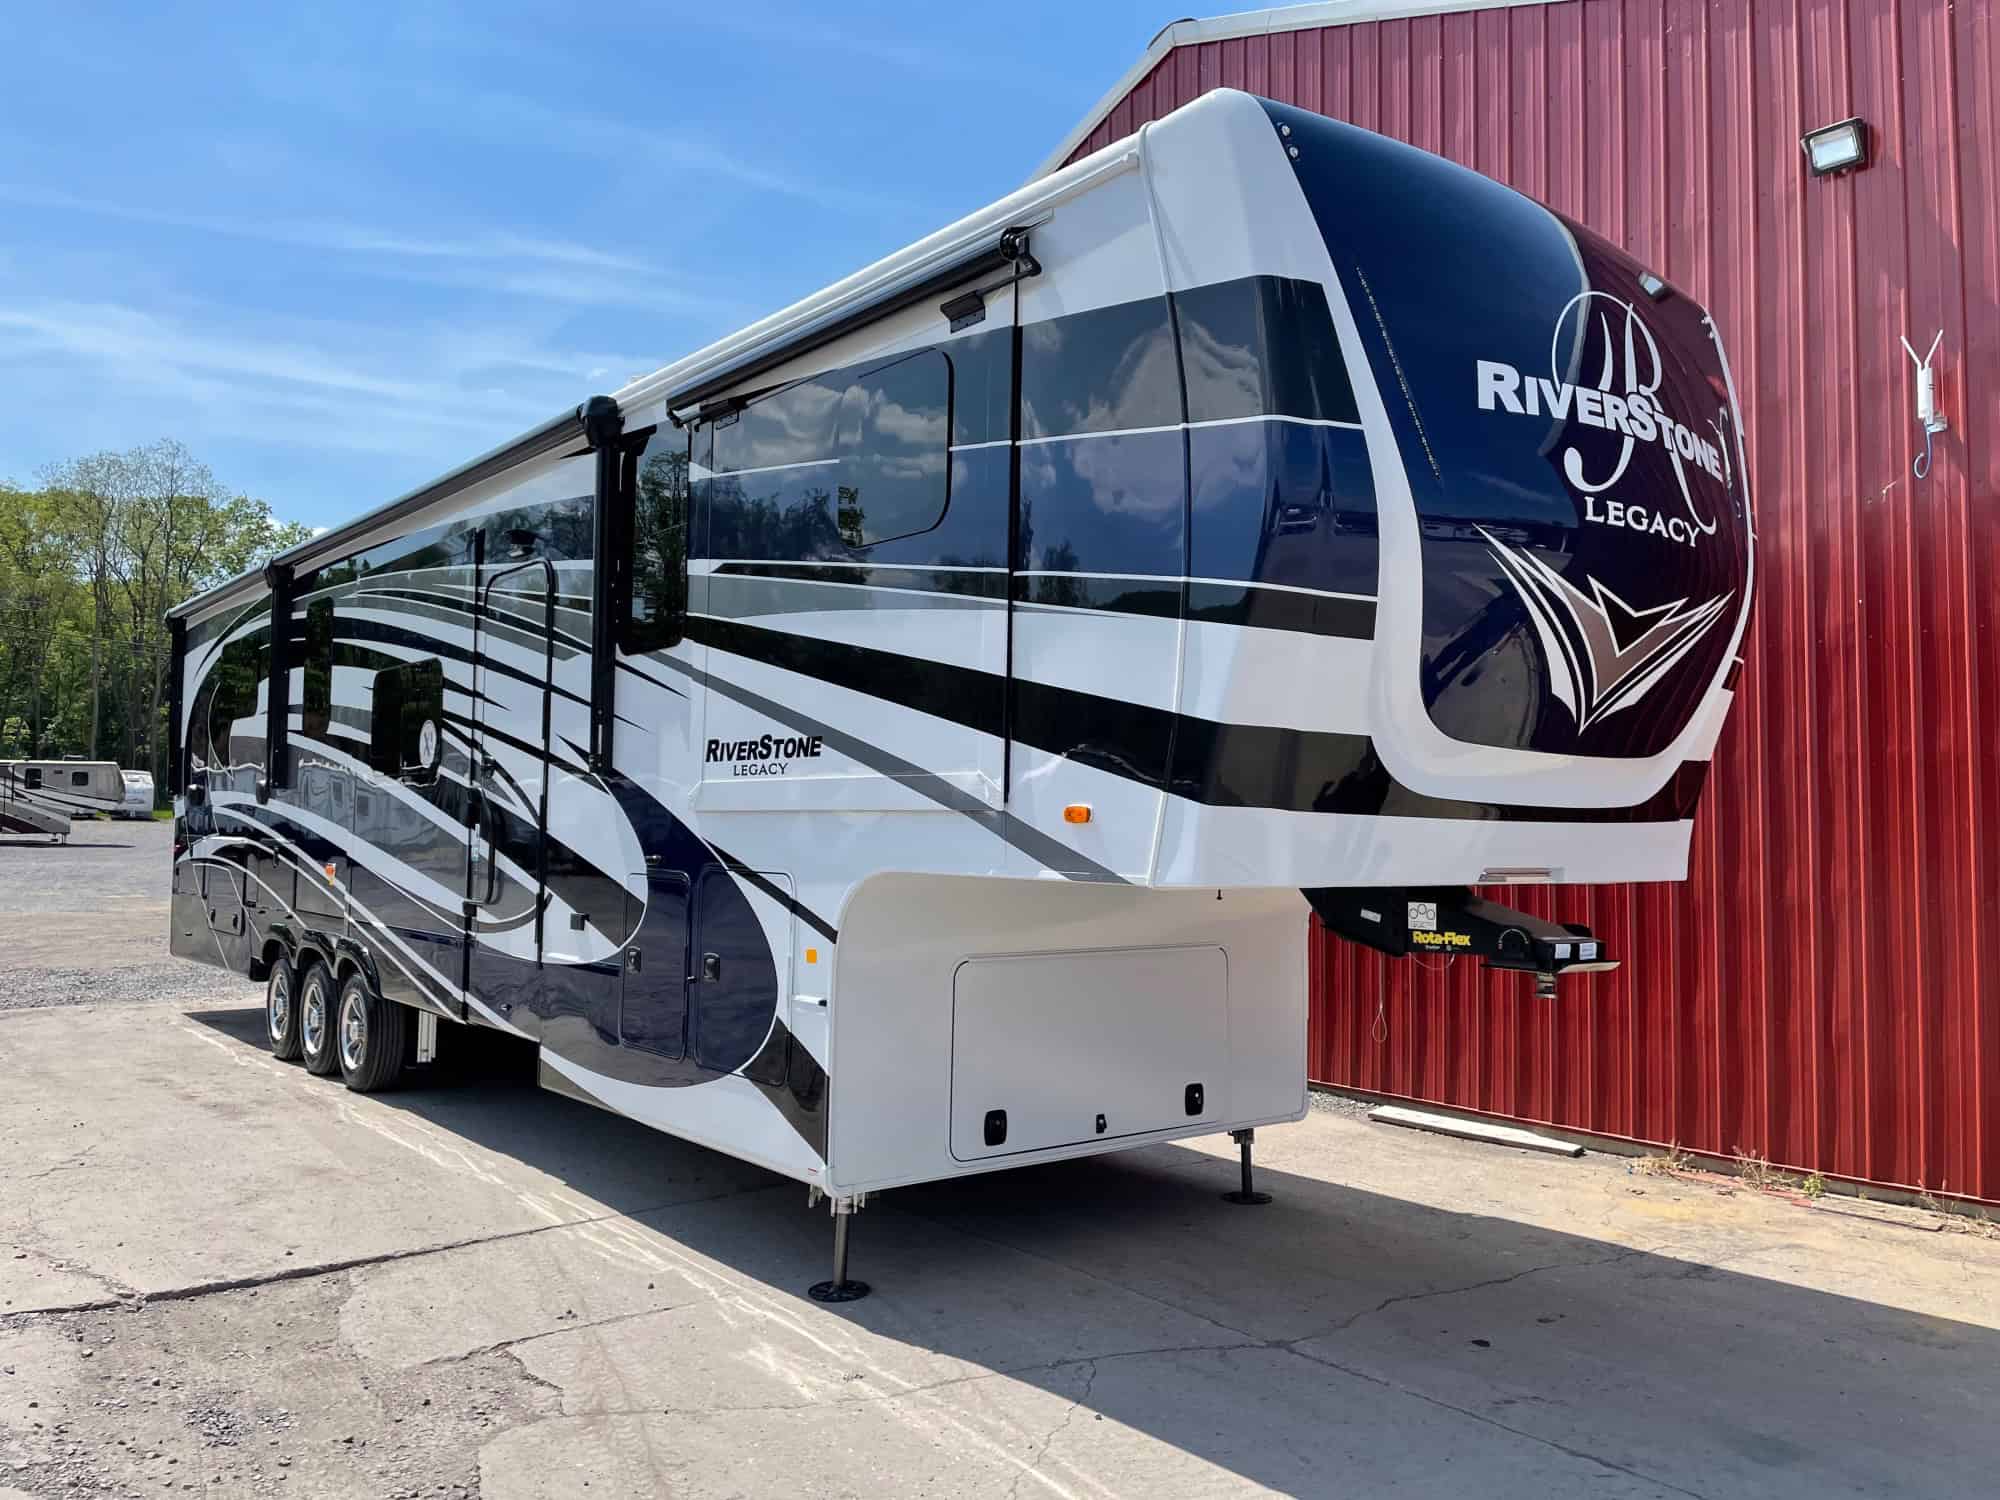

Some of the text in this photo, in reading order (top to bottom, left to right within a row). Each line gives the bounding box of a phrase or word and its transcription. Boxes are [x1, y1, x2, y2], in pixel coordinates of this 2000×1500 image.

[1584, 496, 1700, 548] LEGACY
[733, 763, 788, 776] LEGACY
[1412, 931, 1471, 946] Rota-Flex
